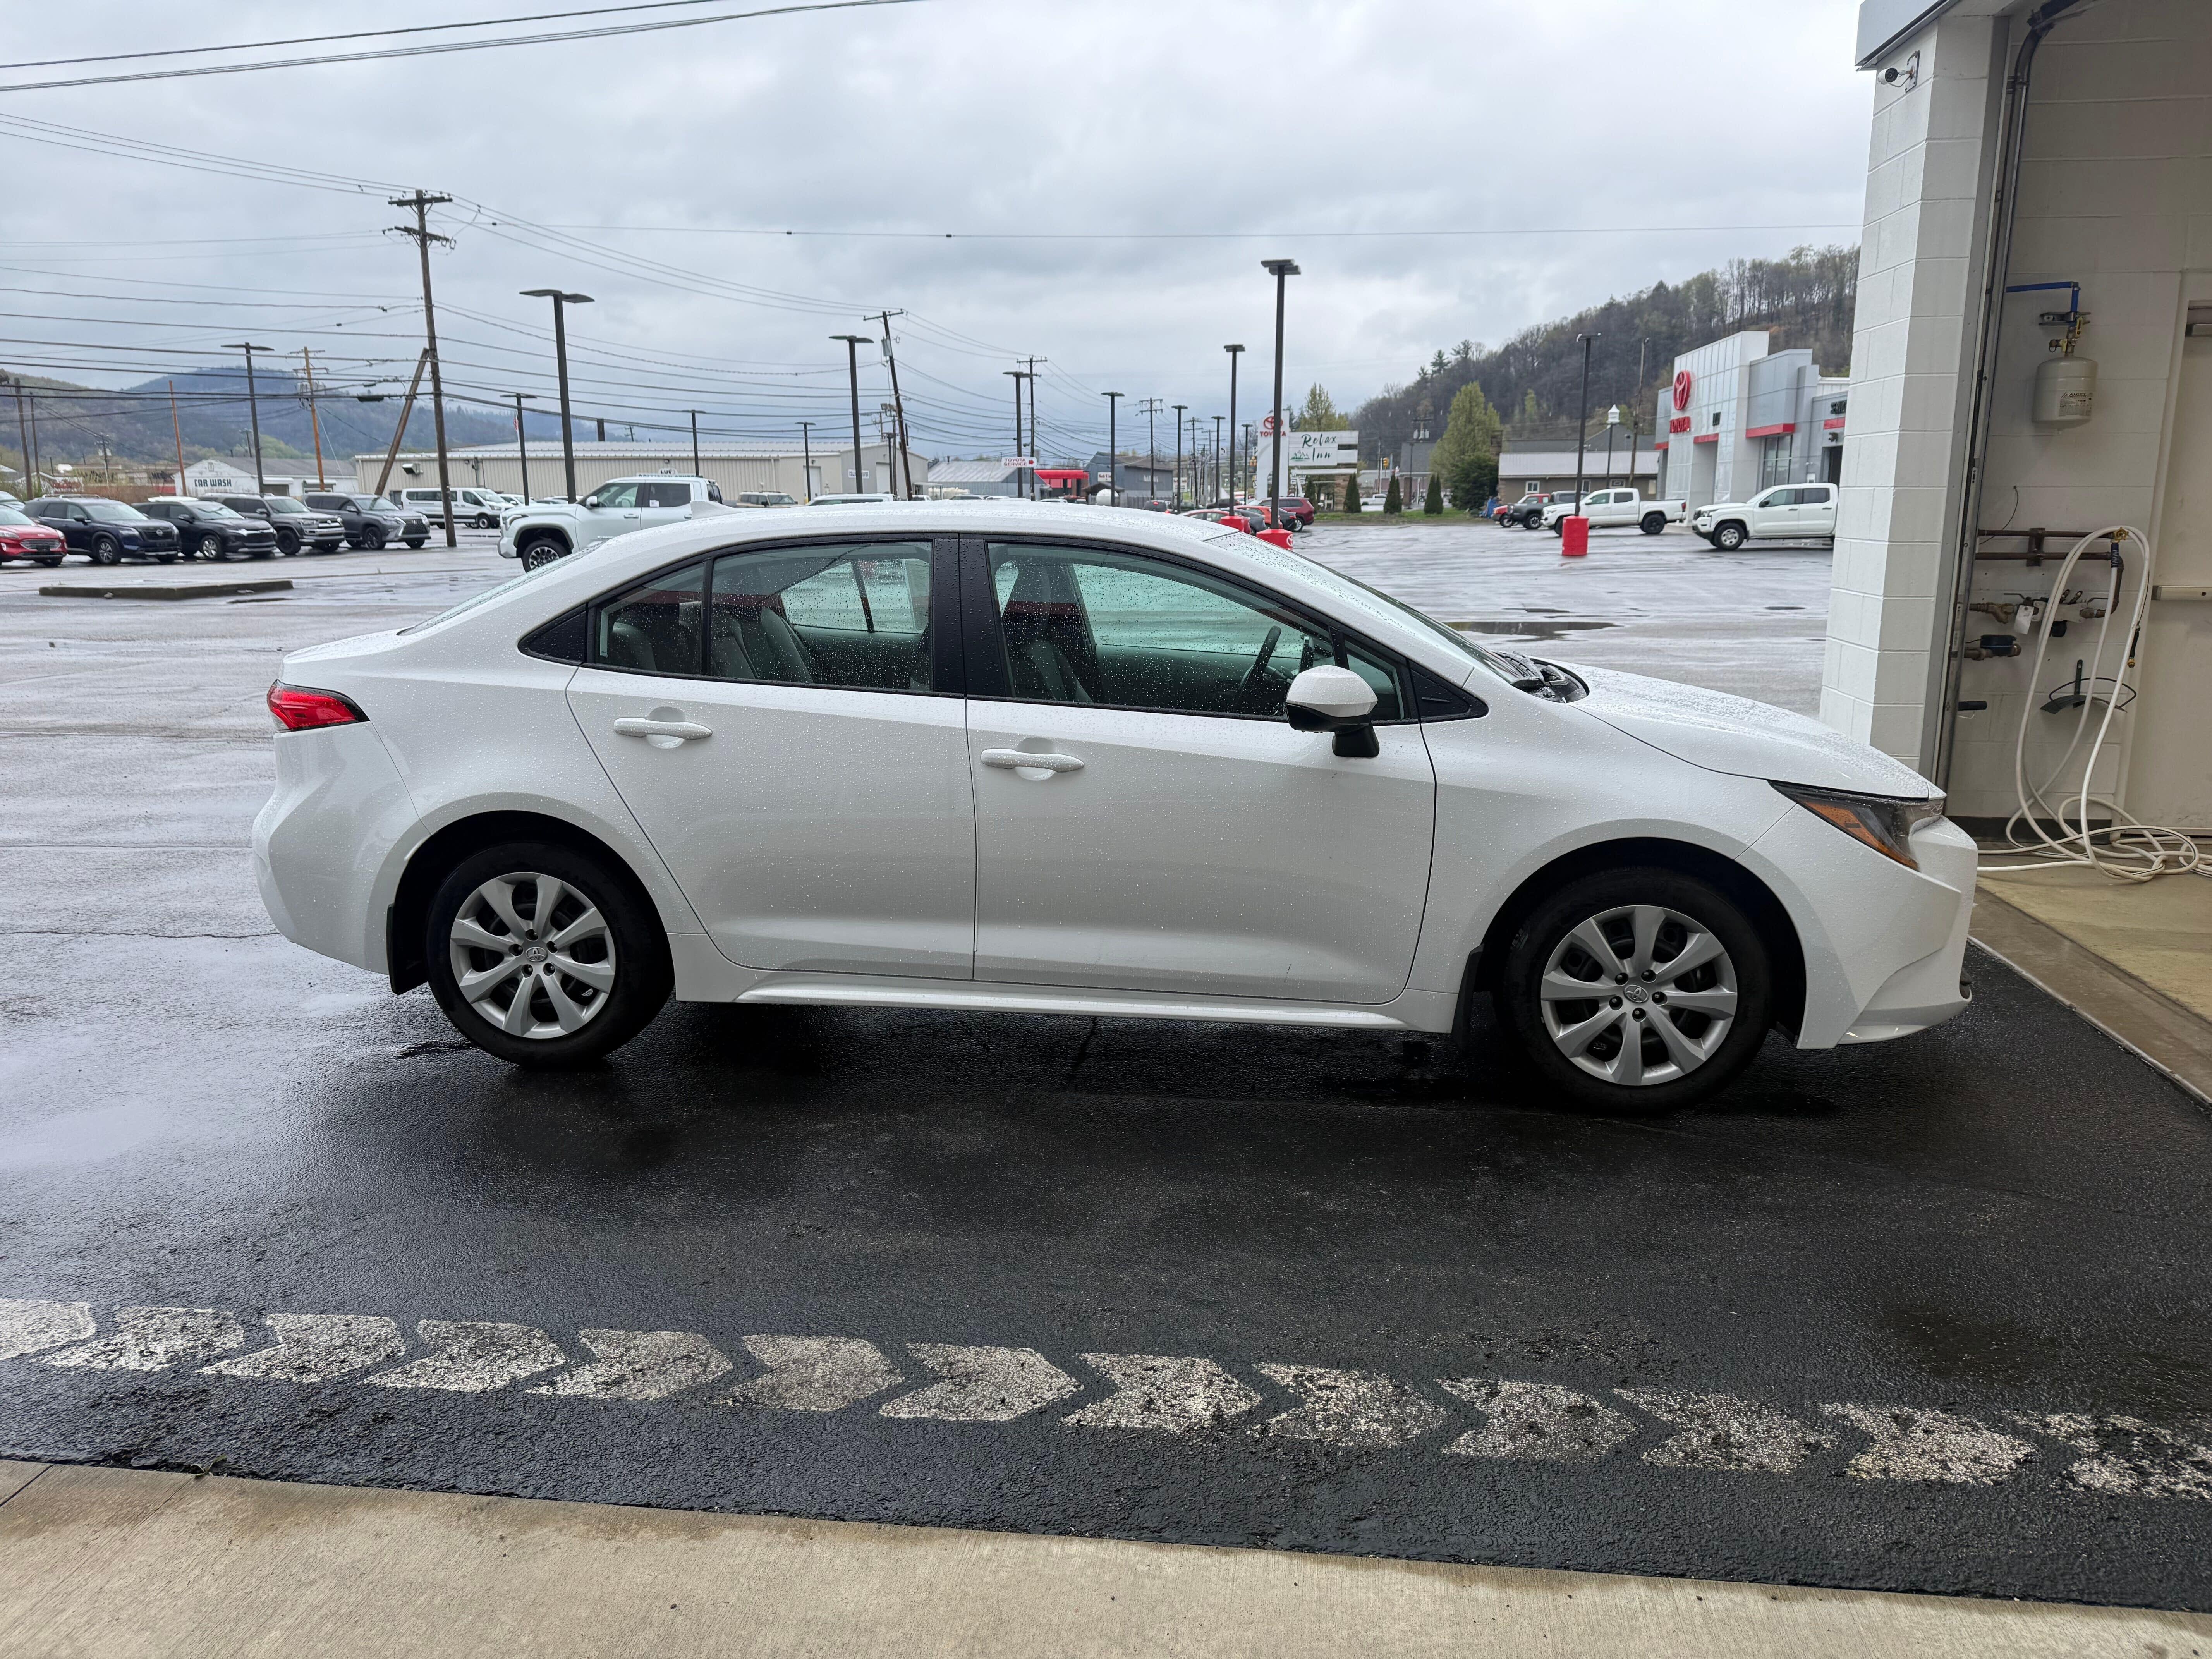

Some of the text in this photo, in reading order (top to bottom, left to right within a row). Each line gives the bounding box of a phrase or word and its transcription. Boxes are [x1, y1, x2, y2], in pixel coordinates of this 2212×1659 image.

[1302, 433, 1336, 448] Relax
[1312, 448, 1332, 461] Inn
[210, 479, 232, 487] WASH
